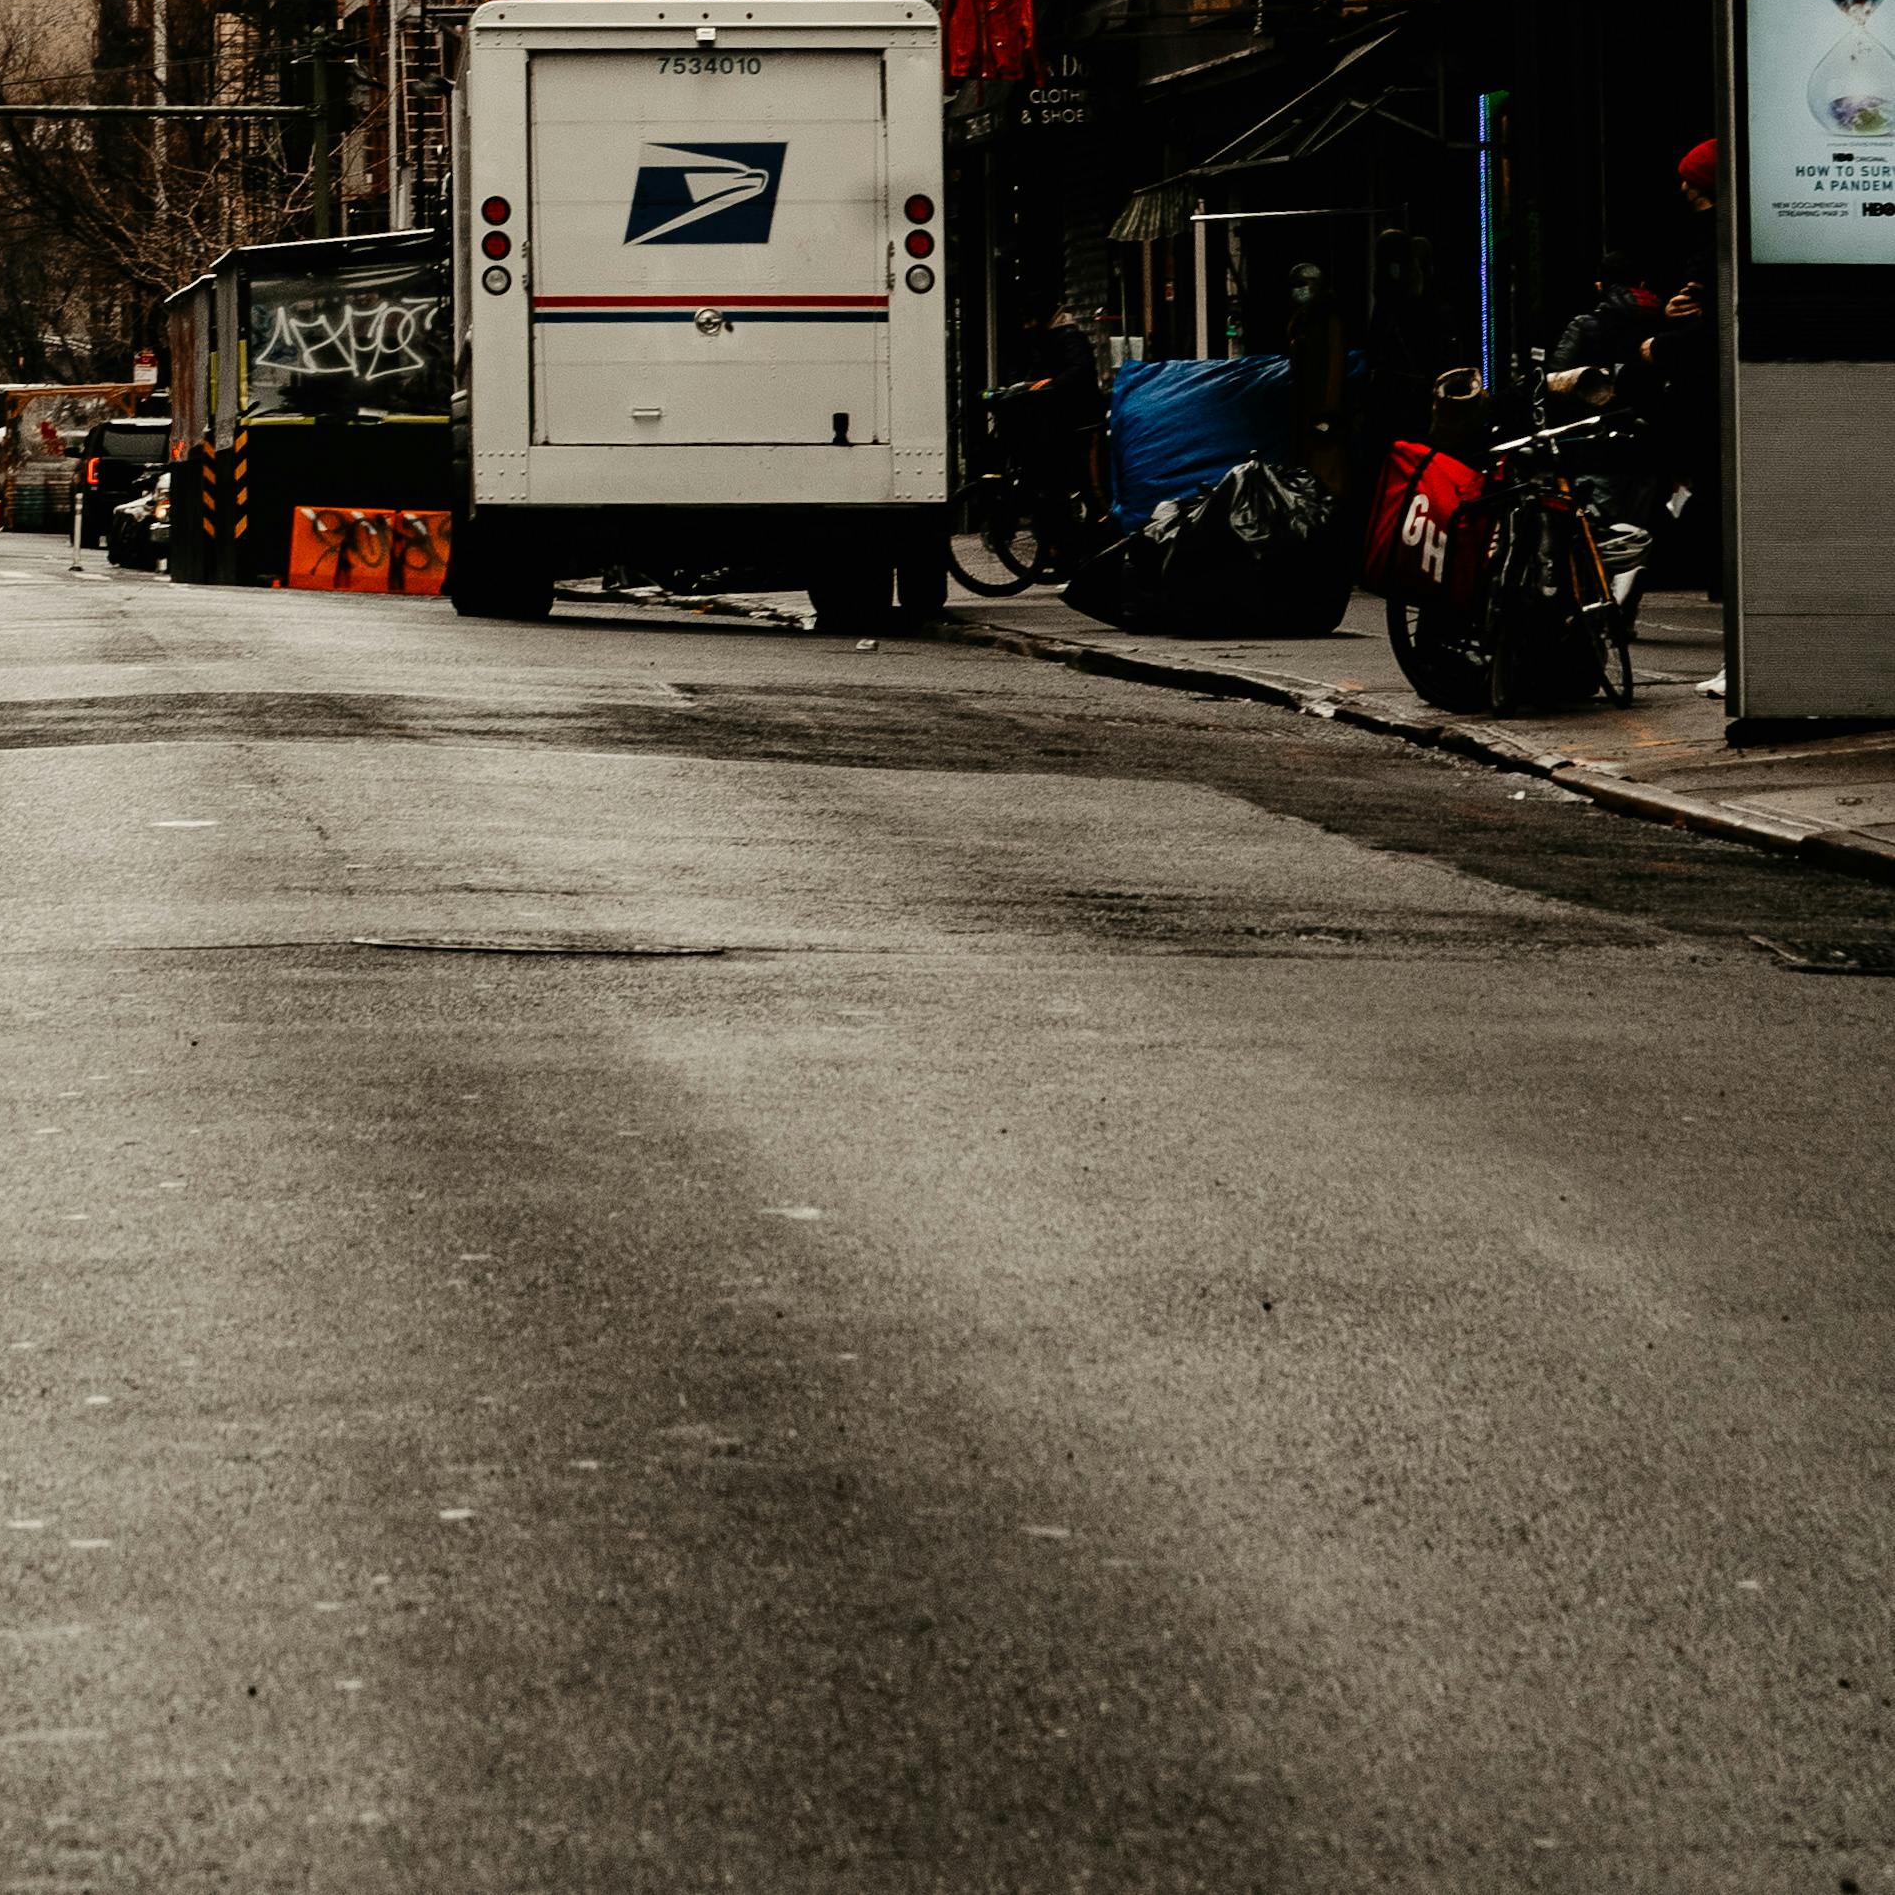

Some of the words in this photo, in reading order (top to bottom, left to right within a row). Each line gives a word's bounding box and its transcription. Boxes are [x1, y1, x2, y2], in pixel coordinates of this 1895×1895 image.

[657, 56, 763, 76] 7534010
[1795, 166, 1830, 177] HOW
[1836, 166, 1854, 177] TO
[1814, 180, 1824, 191] A
[1402, 493, 1448, 584] GH
